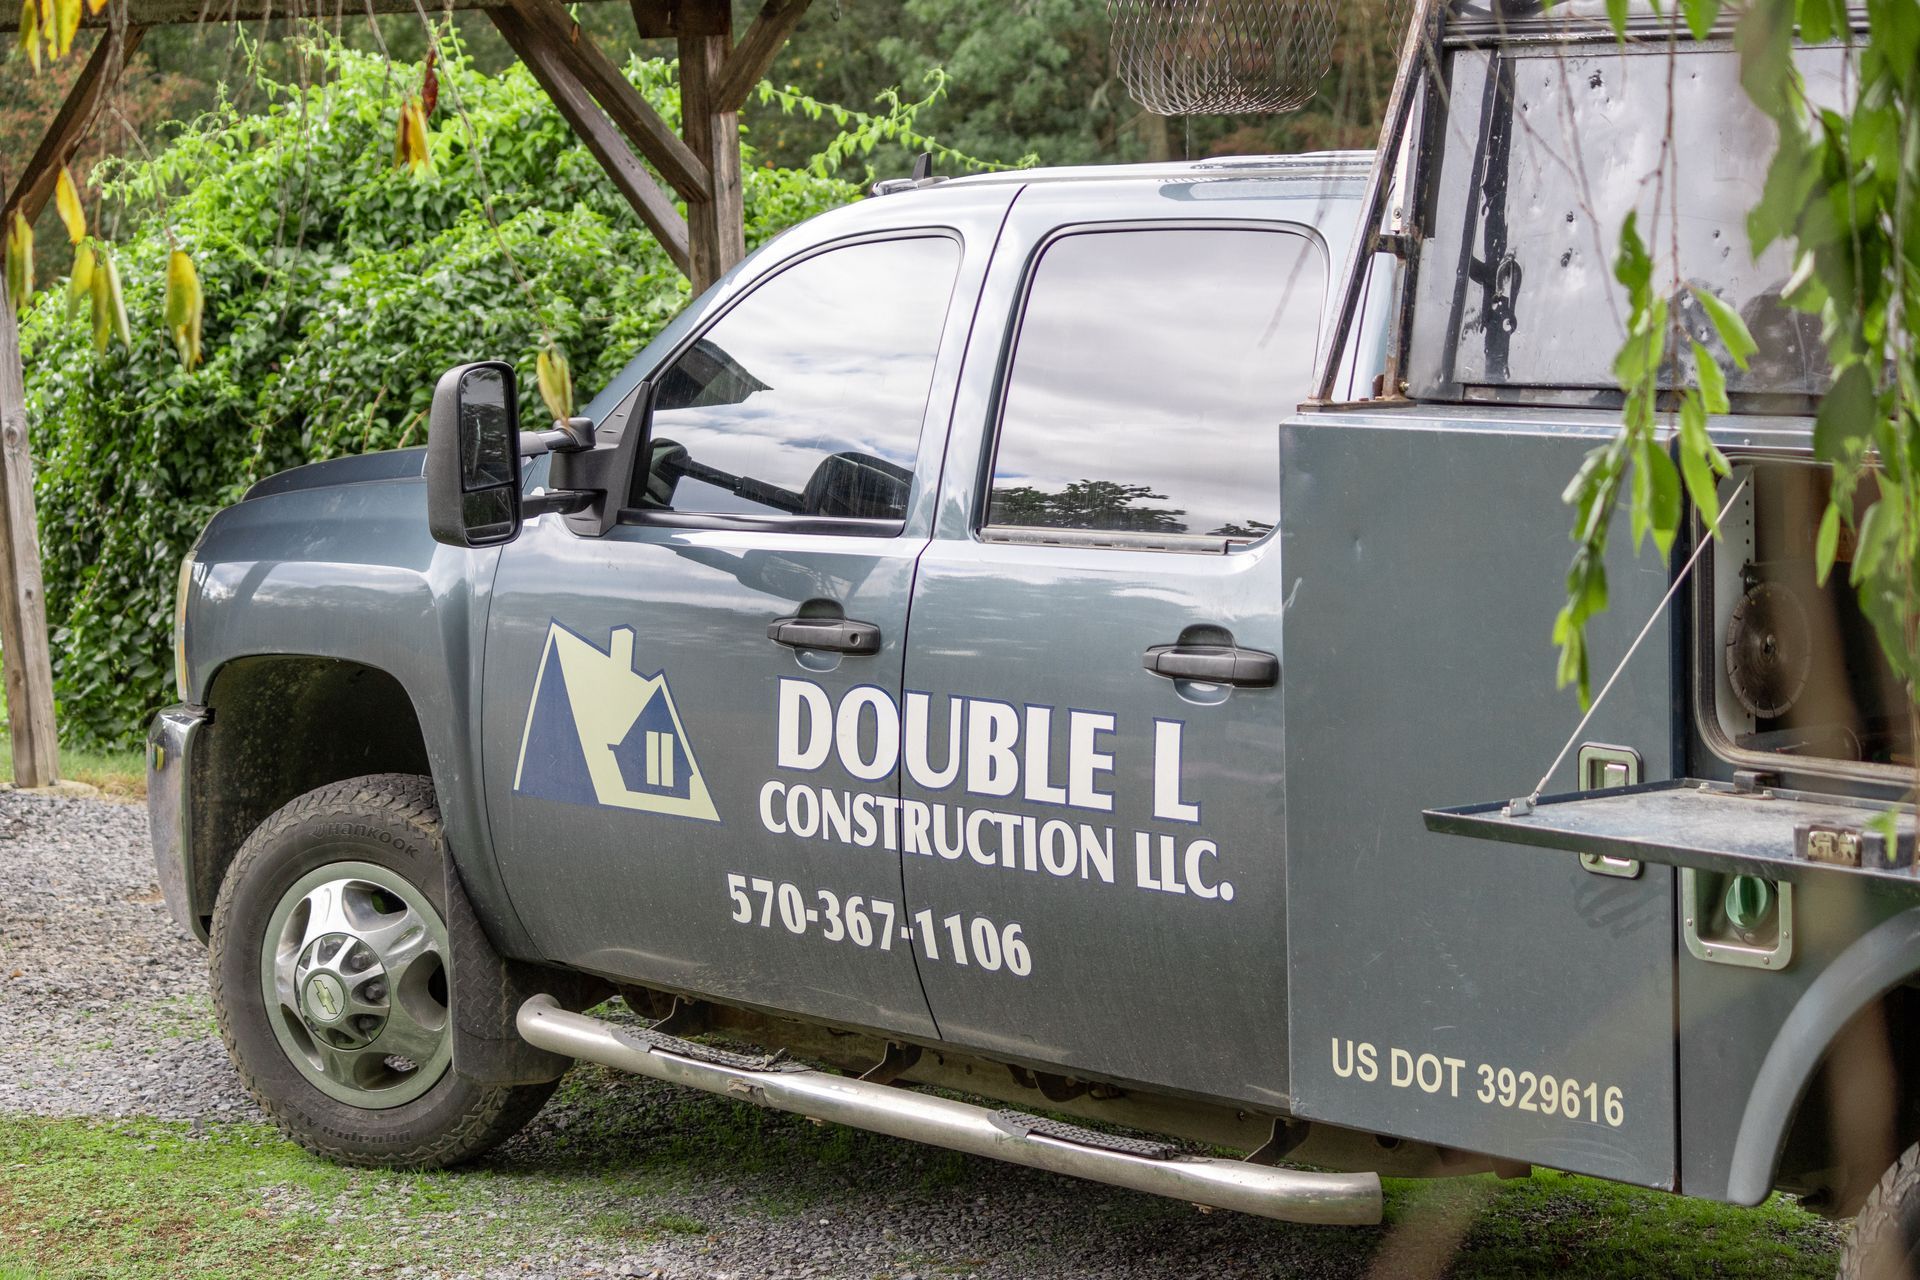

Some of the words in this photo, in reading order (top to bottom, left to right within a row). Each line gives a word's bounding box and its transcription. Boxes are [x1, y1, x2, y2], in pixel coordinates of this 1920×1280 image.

[776, 676, 1116, 812] DOUBLE
[1152, 717, 1199, 824] L
[758, 778, 1116, 884] CONSTRUCTION
[1135, 831, 1235, 902] LLC.
[727, 873, 1033, 977] 570-367-1106
[1331, 1037, 1378, 1082] US
[1390, 1047, 1466, 1098] DOT
[1476, 1063, 1625, 1127] 3929616
